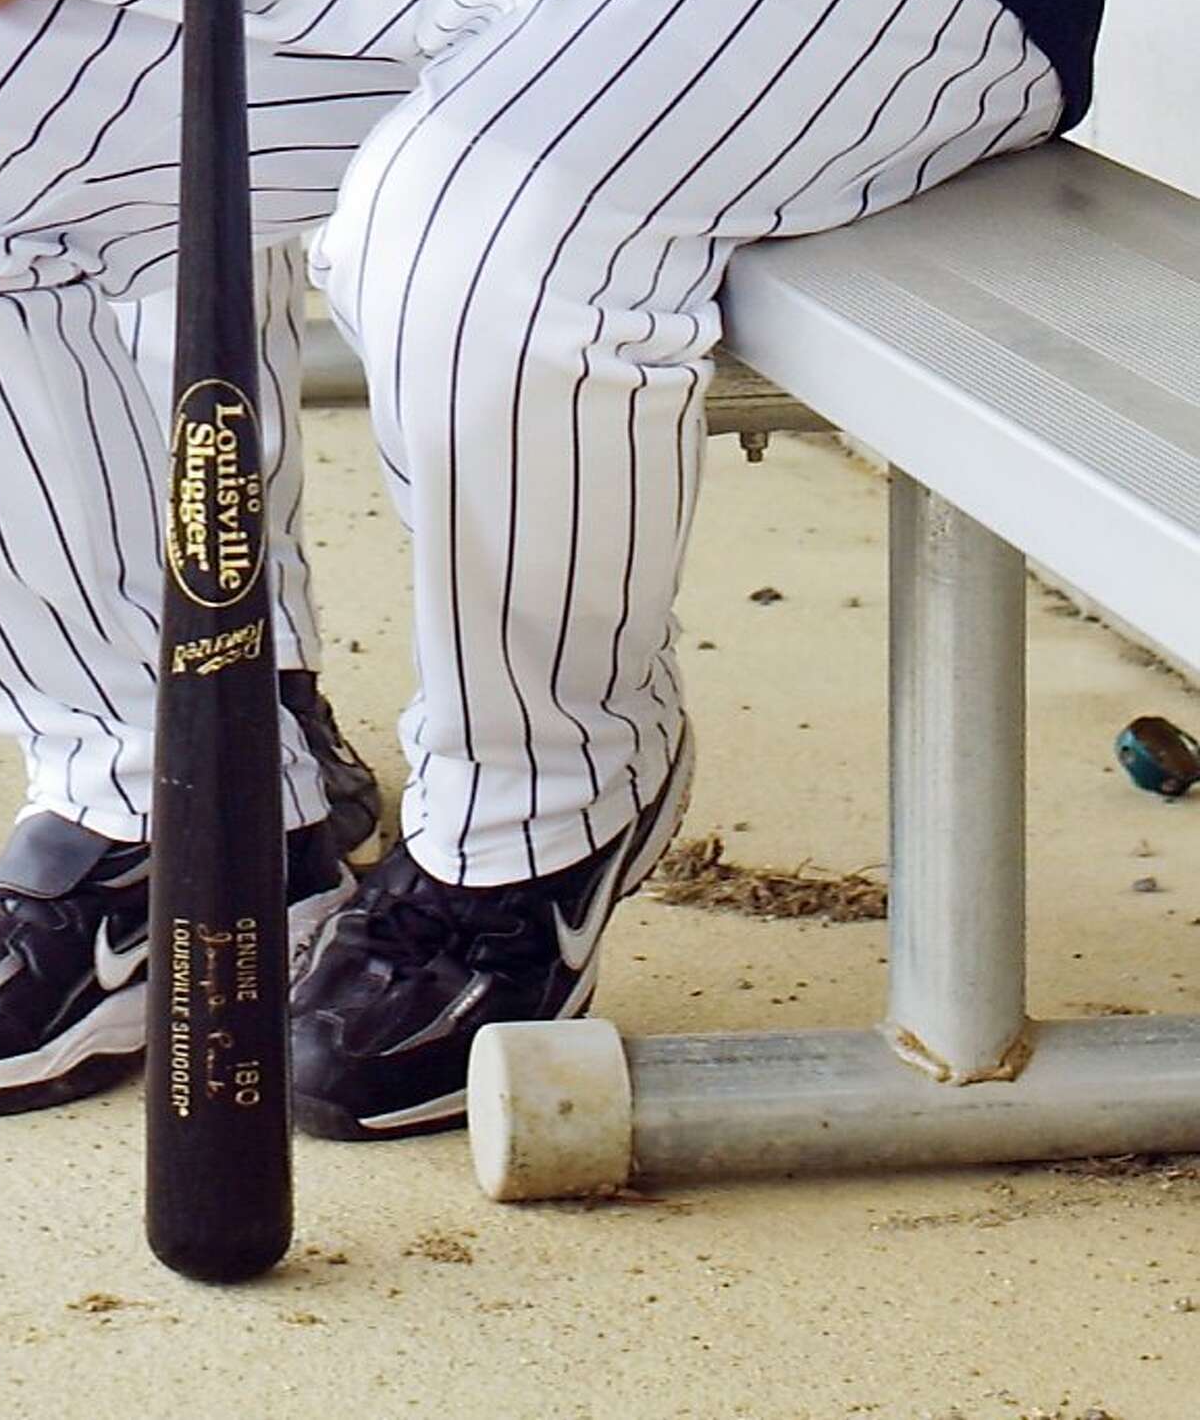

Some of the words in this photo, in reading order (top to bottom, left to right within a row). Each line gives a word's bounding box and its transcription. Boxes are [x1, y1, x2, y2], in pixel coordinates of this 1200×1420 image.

[178, 422, 216, 561] Slugger
[215, 403, 250, 590] Louisville
[172, 918, 190, 1018] LOUISVILLE
[235, 917, 259, 1003] GENUINE
[234, 1060, 261, 1106] 180
